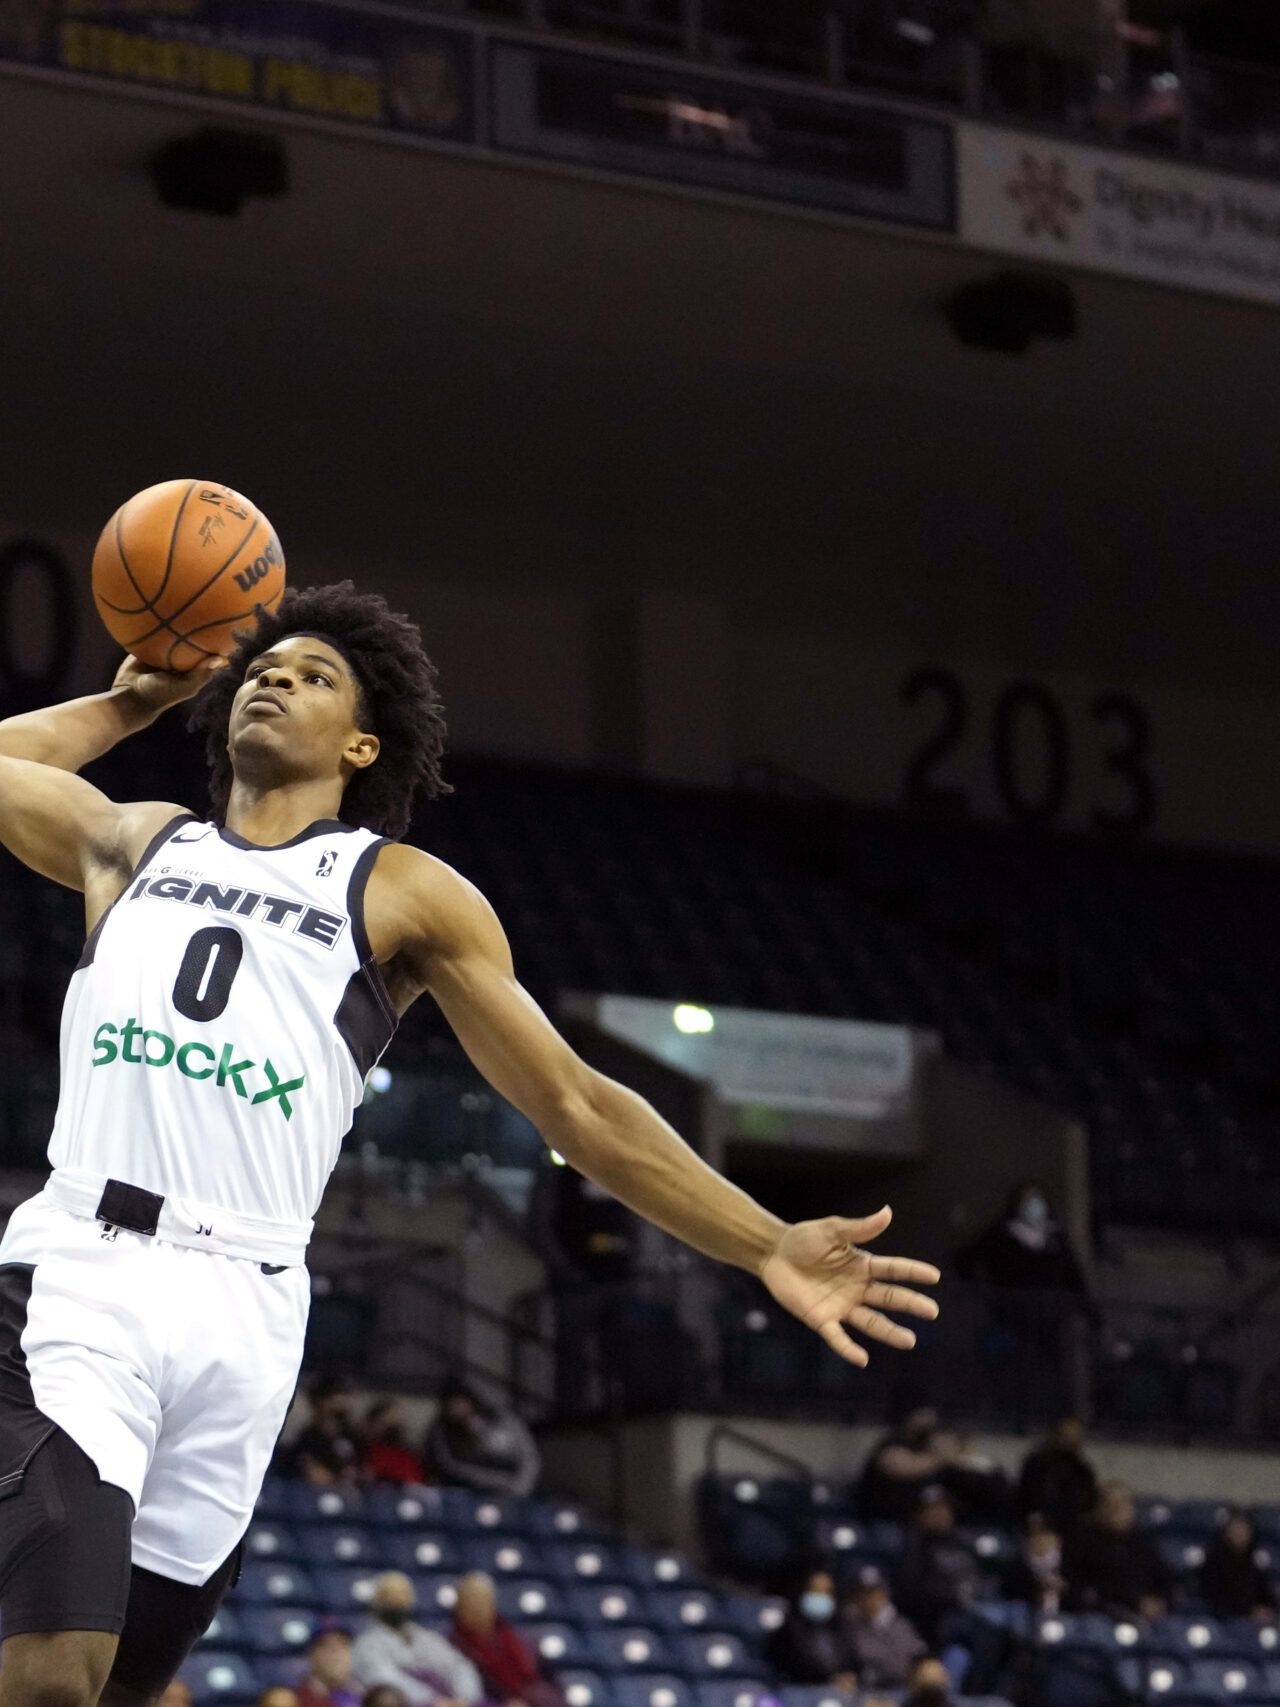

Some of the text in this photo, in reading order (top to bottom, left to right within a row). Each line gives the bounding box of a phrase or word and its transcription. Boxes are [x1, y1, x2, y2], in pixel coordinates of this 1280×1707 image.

[898, 666, 1156, 832] 203
[128, 875, 346, 949] IGNITE
[172, 926, 243, 1023] 0
